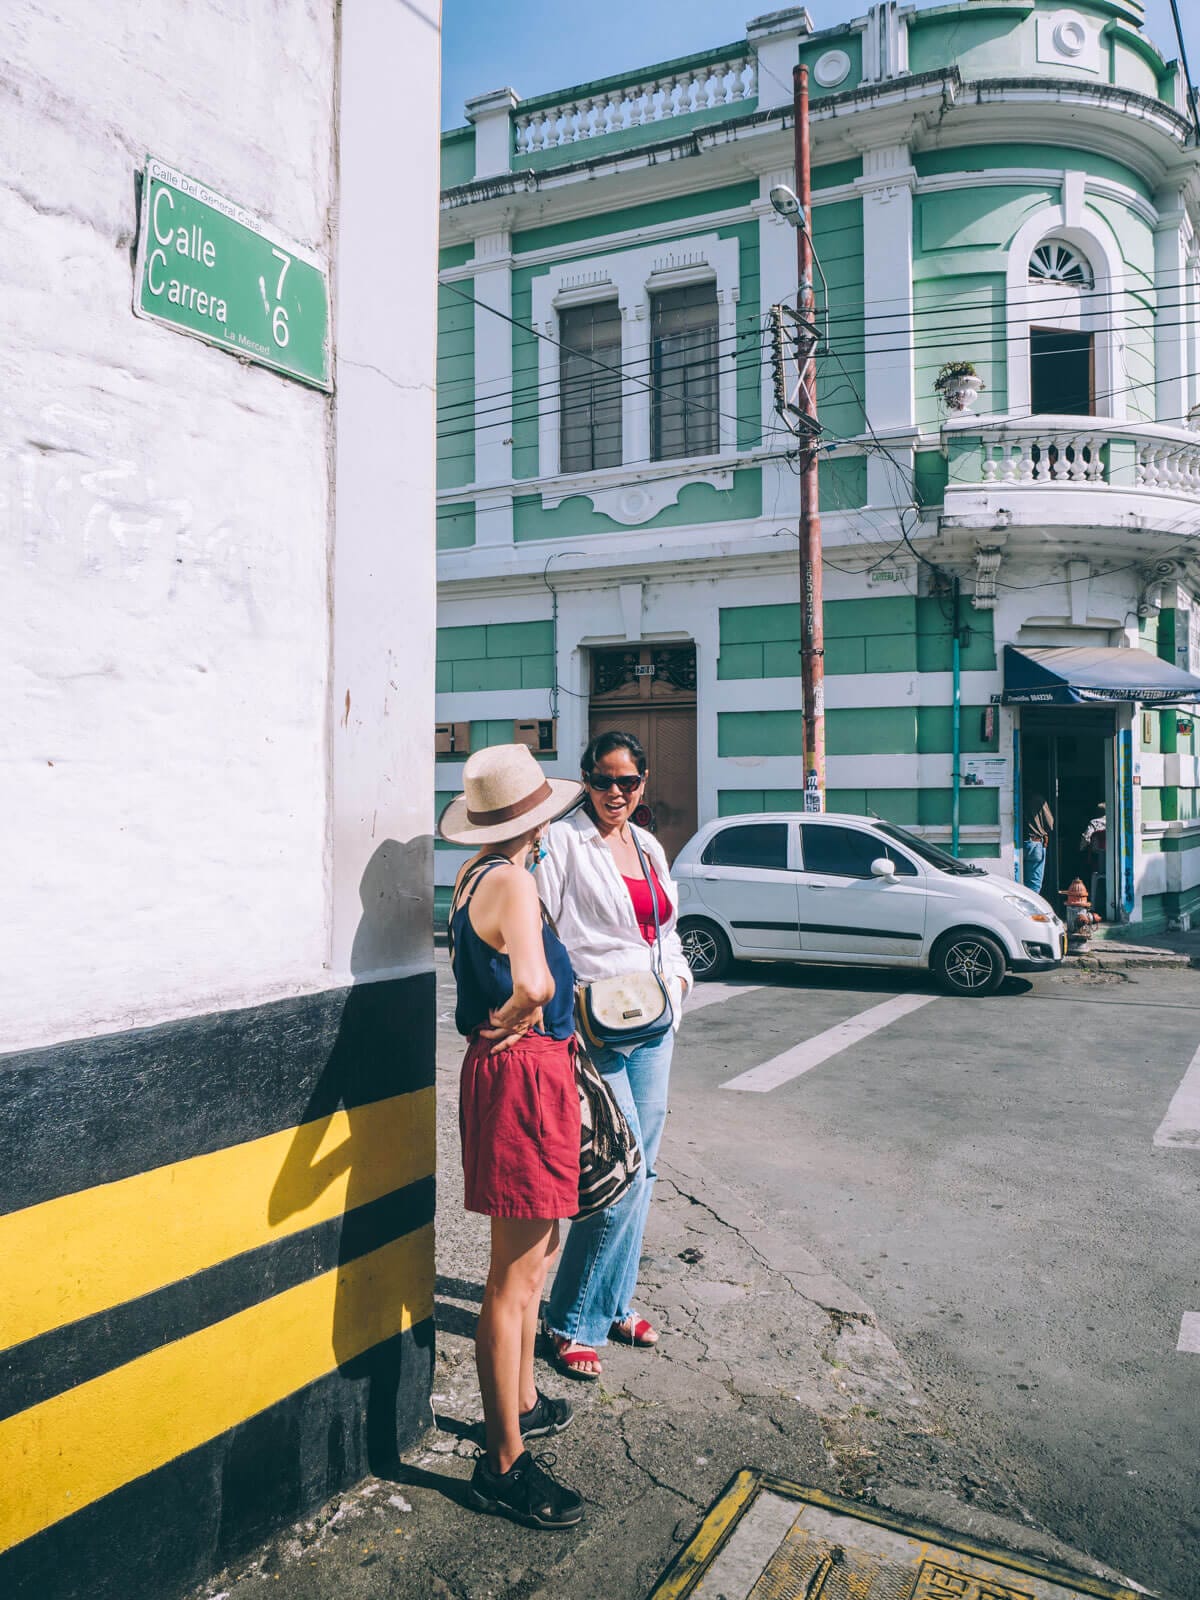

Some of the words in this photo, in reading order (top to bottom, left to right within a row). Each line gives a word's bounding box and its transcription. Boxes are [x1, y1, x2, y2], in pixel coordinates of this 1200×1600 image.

[152, 164, 178, 186] Calle
[181, 179, 198, 197] Del
[200, 190, 236, 217] General
[154, 187, 217, 268] Calle
[271, 248, 292, 301] 7
[148, 249, 228, 324] Carrera
[272, 306, 289, 348] 6
[223, 327, 236, 341] La
[238, 333, 271, 356] Merced
